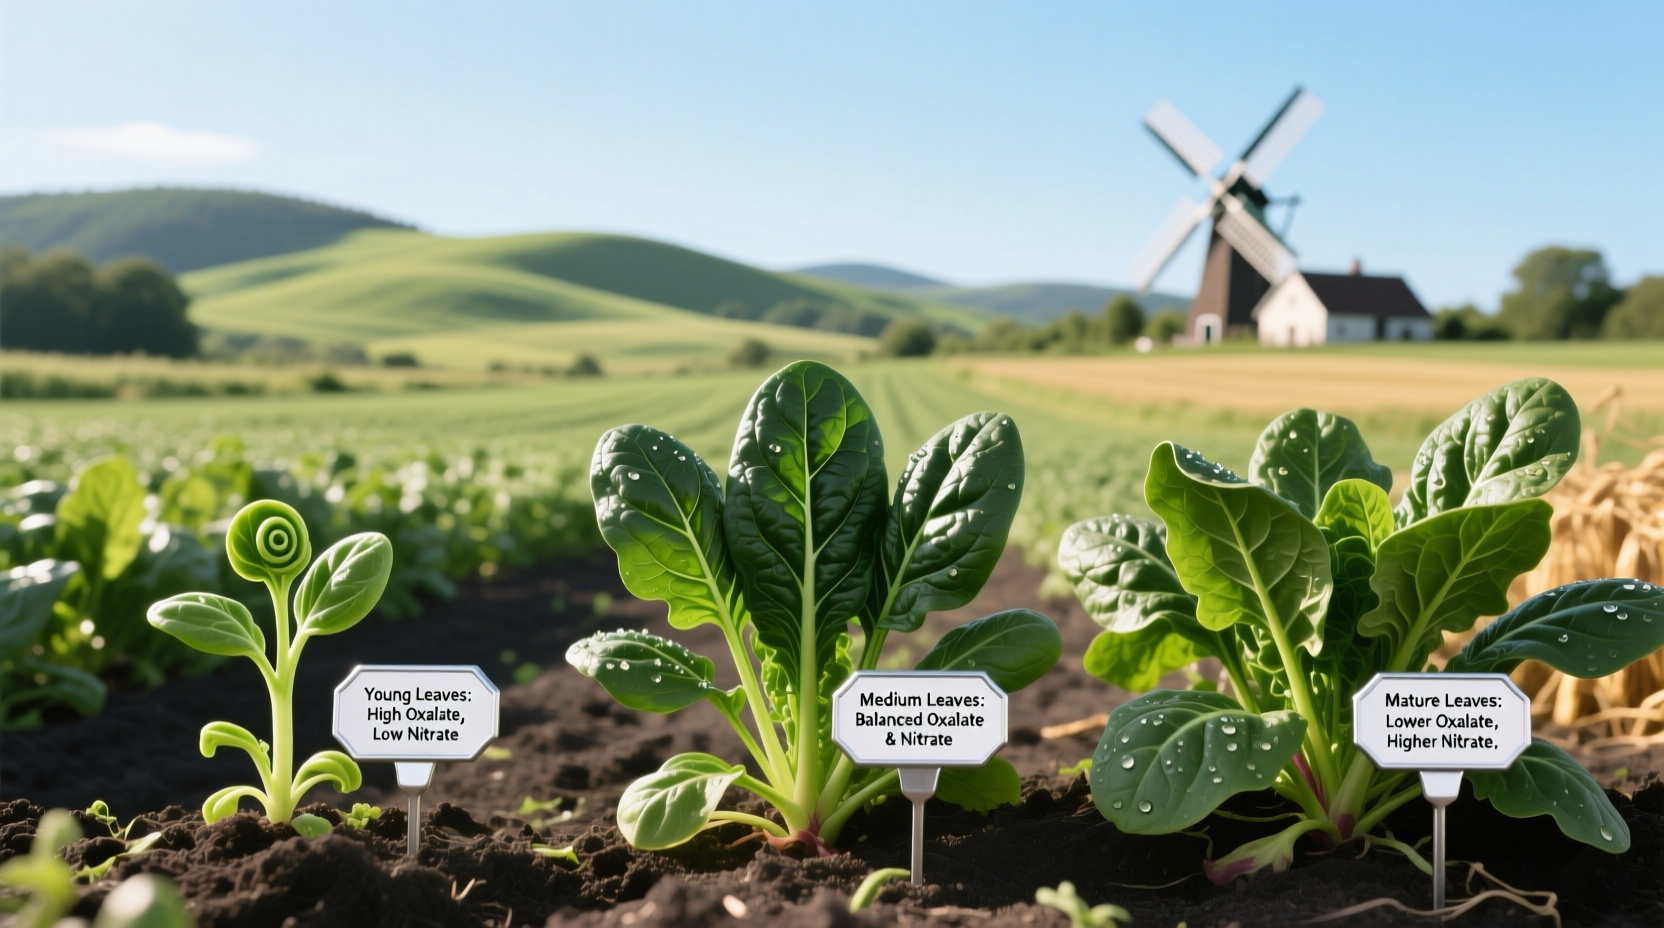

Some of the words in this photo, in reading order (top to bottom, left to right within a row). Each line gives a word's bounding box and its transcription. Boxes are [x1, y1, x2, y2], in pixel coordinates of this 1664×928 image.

[364, 687, 411, 705] Young
[416, 687, 472, 702] Leaves:
[860, 692, 922, 707] Medium
[927, 692, 985, 707] Leaves:
[1385, 693, 1440, 707] Mature
[1445, 693, 1502, 708] Leaves:
[368, 707, 401, 724] High
[406, 707, 465, 725] Oxalate,
[856, 712, 922, 726] Balanced
[927, 712, 984, 727] Oxalate
[1386, 715, 1431, 728] Lower
[1436, 714, 1499, 730] Oxalate,
[373, 728, 403, 741] Low
[408, 727, 459, 741] Nitrate
[885, 732, 896, 745] &
[901, 732, 953, 746] Nitrate
[1387, 734, 1437, 752] Higher
